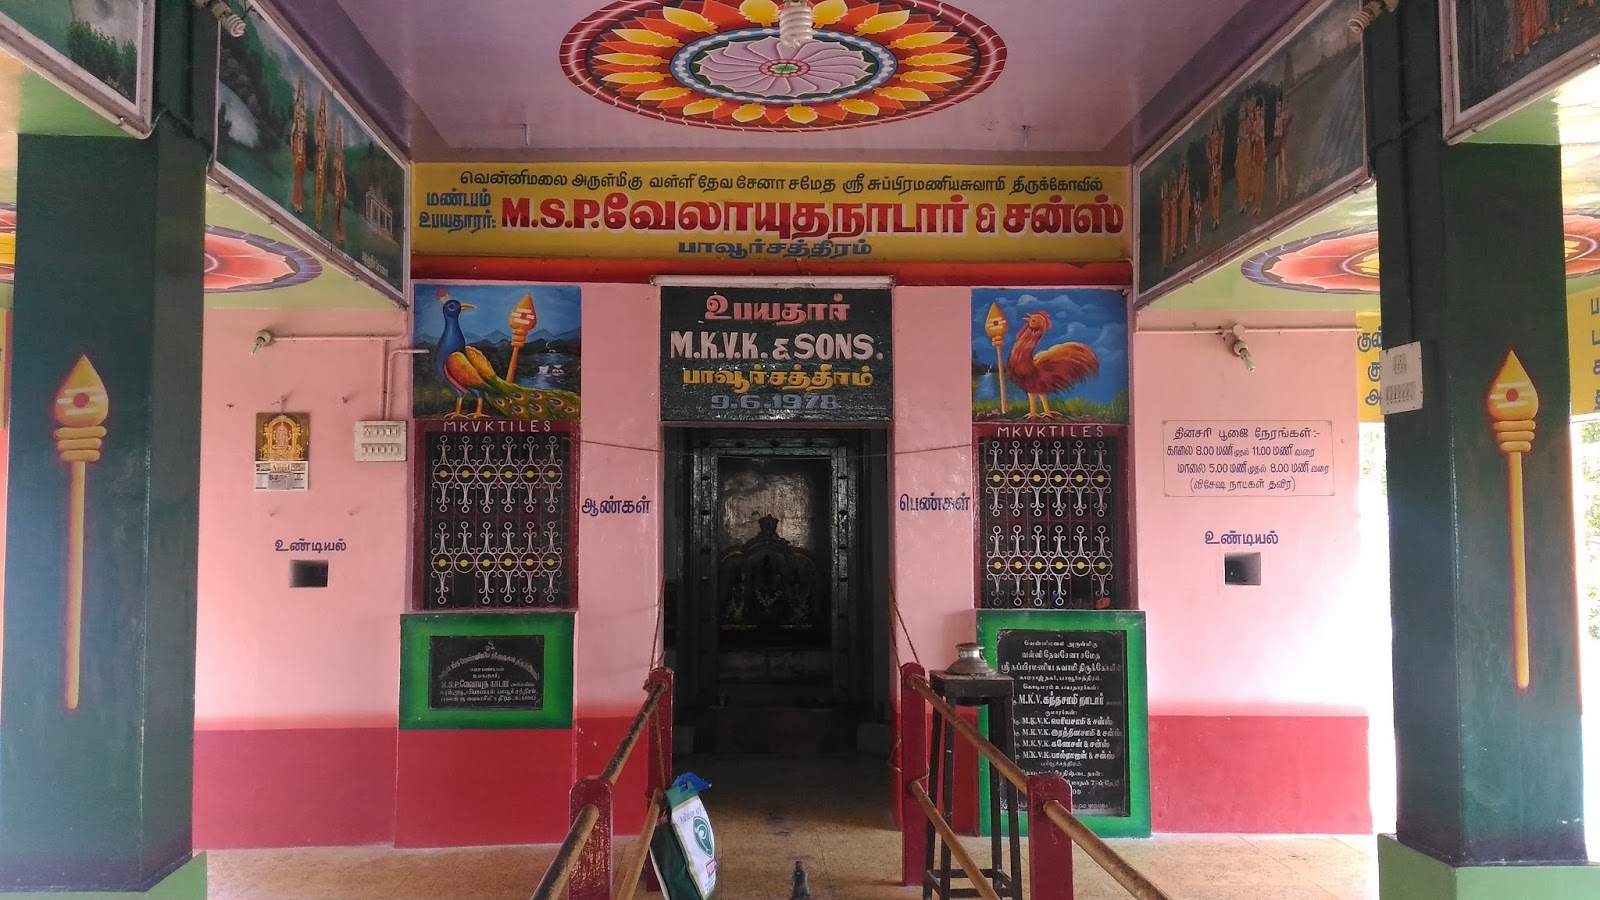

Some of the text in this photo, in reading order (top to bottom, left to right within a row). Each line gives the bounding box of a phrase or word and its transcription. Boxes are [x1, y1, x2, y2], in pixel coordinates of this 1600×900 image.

[459, 169, 566, 187] வென்னிமலை
[571, 171, 643, 190] அருள்மிகு
[648, 173, 697, 191] வள்ளி
[1008, 176, 1104, 195] திருக்கோவில்
[426, 188, 492, 206] மண்டபம்
[1002, 193, 1124, 234] சன்ஸ்
[678, 239, 872, 261] பாவூர்சத்திரம்
[670, 331, 768, 361] M.K.V.K.
[710, 394, 840, 411] 9.6.1978
[1172, 426, 1213, 441] தினசரி
[1218, 427, 1249, 442] பூஜை
[1166, 444, 1315, 458] காலை 8.00 மணி முதல் 11.00 மணி வரை
[1177, 461, 1330, 476] மாலை 5.00 மணி முதல் 8.00 மணி வரை
[1227, 478, 1265, 492] நாட்கள்
[580, 493, 652, 517] ஆண்கள்
[899, 491, 970, 512] பெண்கள்
[275, 537, 347, 554] உண்டியல்
[1205, 530, 1278, 547] உண்டியல்
